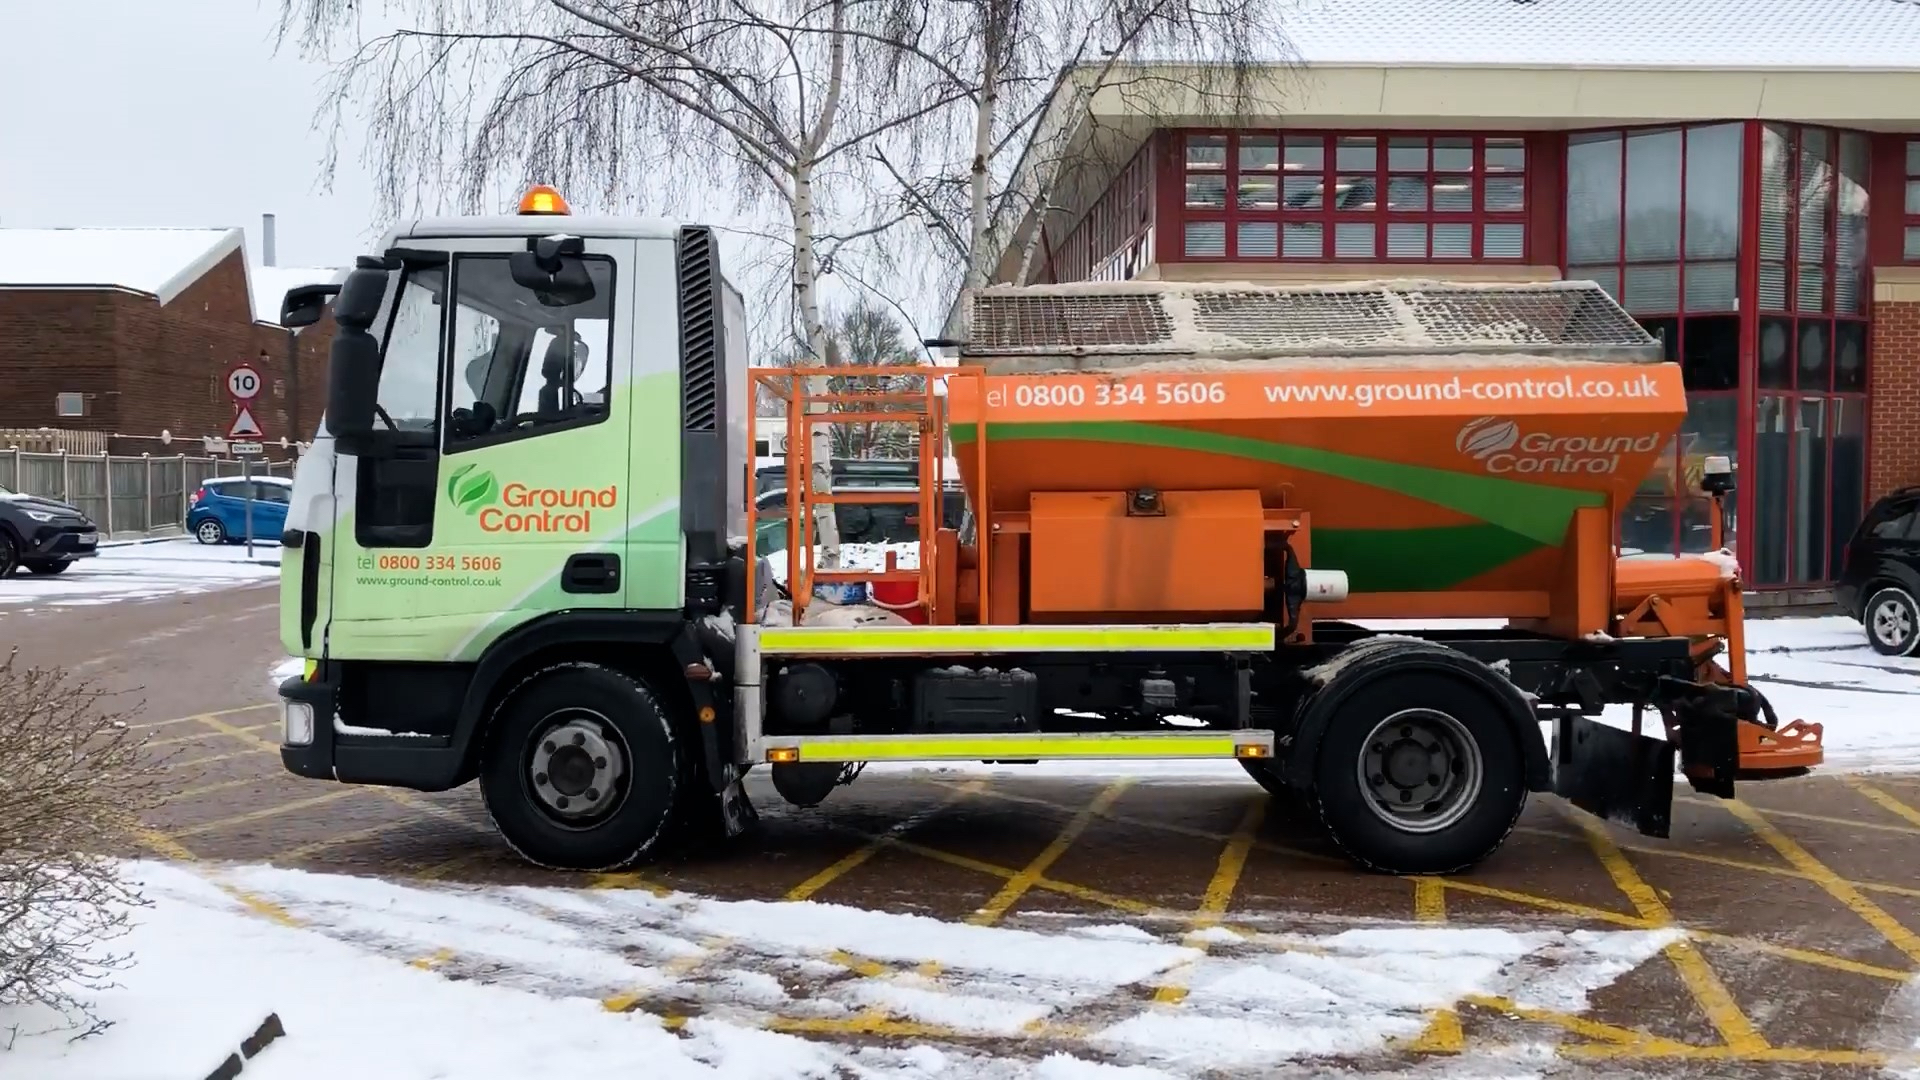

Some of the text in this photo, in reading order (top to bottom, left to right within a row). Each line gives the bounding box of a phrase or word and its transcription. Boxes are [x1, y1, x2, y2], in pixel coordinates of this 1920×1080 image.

[233, 375, 255, 391] 10
[986, 381, 1226, 408] el 0800 334 5606
[1263, 373, 1660, 408] www.ground-control.co.uk
[1519, 431, 1660, 454] Ground
[1486, 454, 1619, 474] Control
[502, 483, 616, 508] Ground
[479, 508, 591, 533] Control
[356, 554, 502, 571] tel 0800 334 5606
[355, 575, 502, 589] www.ground-control.co.uk
